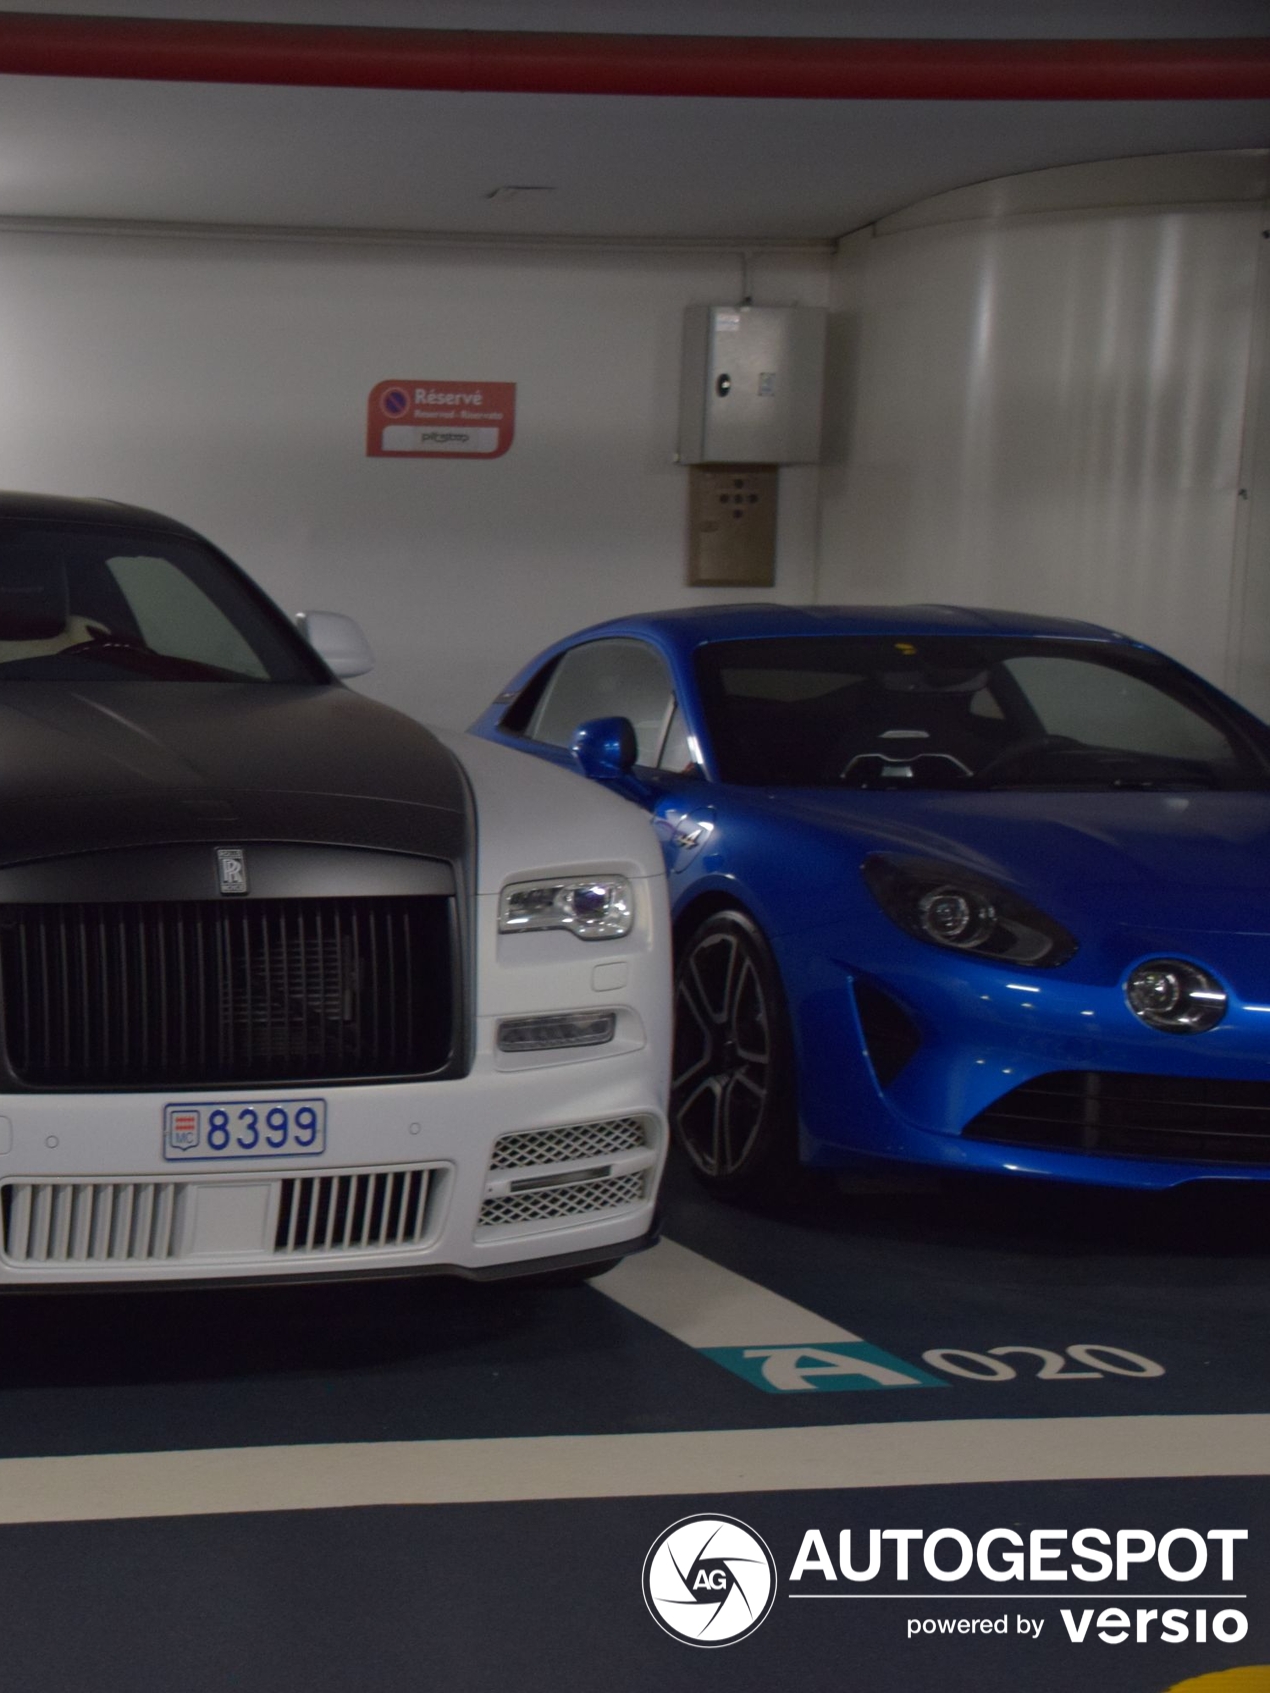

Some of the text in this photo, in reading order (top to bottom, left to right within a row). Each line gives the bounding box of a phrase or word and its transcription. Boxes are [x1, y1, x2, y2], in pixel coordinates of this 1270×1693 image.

[415, 388, 483, 406] Réservé
[175, 1106, 318, 1150] MC 8399
[743, 1343, 1166, 1391] A 020
